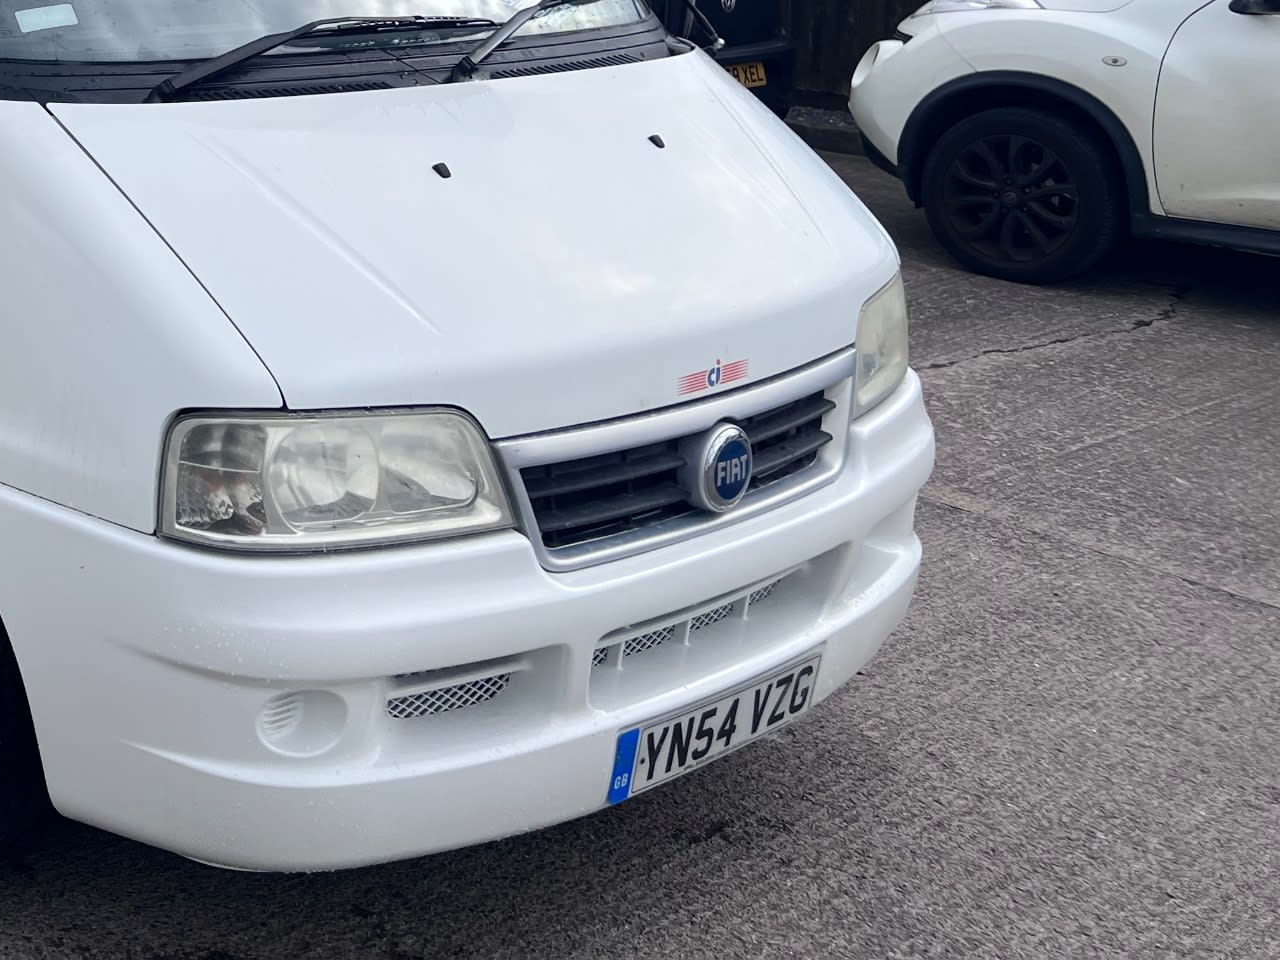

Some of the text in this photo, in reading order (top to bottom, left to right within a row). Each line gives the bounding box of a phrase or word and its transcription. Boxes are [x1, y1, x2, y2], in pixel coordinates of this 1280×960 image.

[742, 64, 763, 83] XEL
[716, 454, 748, 487] FIAT
[646, 665, 814, 781] YN54 VZG
[614, 773, 629, 790] GB
